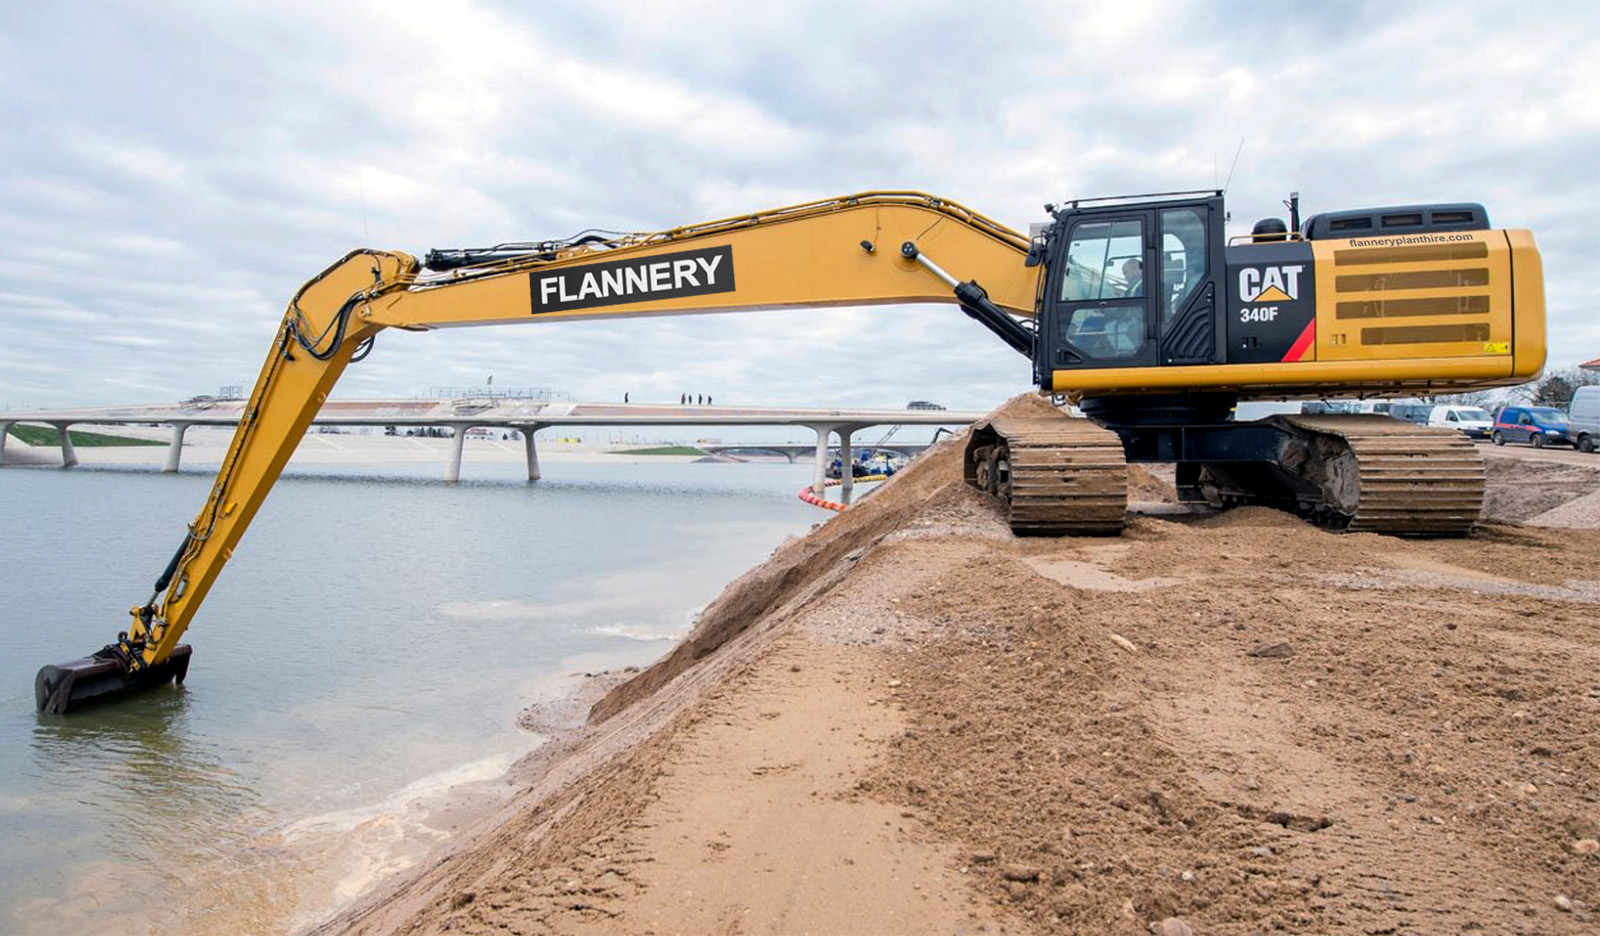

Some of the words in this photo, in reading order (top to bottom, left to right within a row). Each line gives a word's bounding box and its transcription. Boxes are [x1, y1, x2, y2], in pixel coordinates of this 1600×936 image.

[1349, 234, 1474, 247] flanneryplanthire.com
[540, 254, 723, 305] FLANNERY
[1239, 265, 1303, 303] CAT
[1240, 306, 1278, 323] 340F
